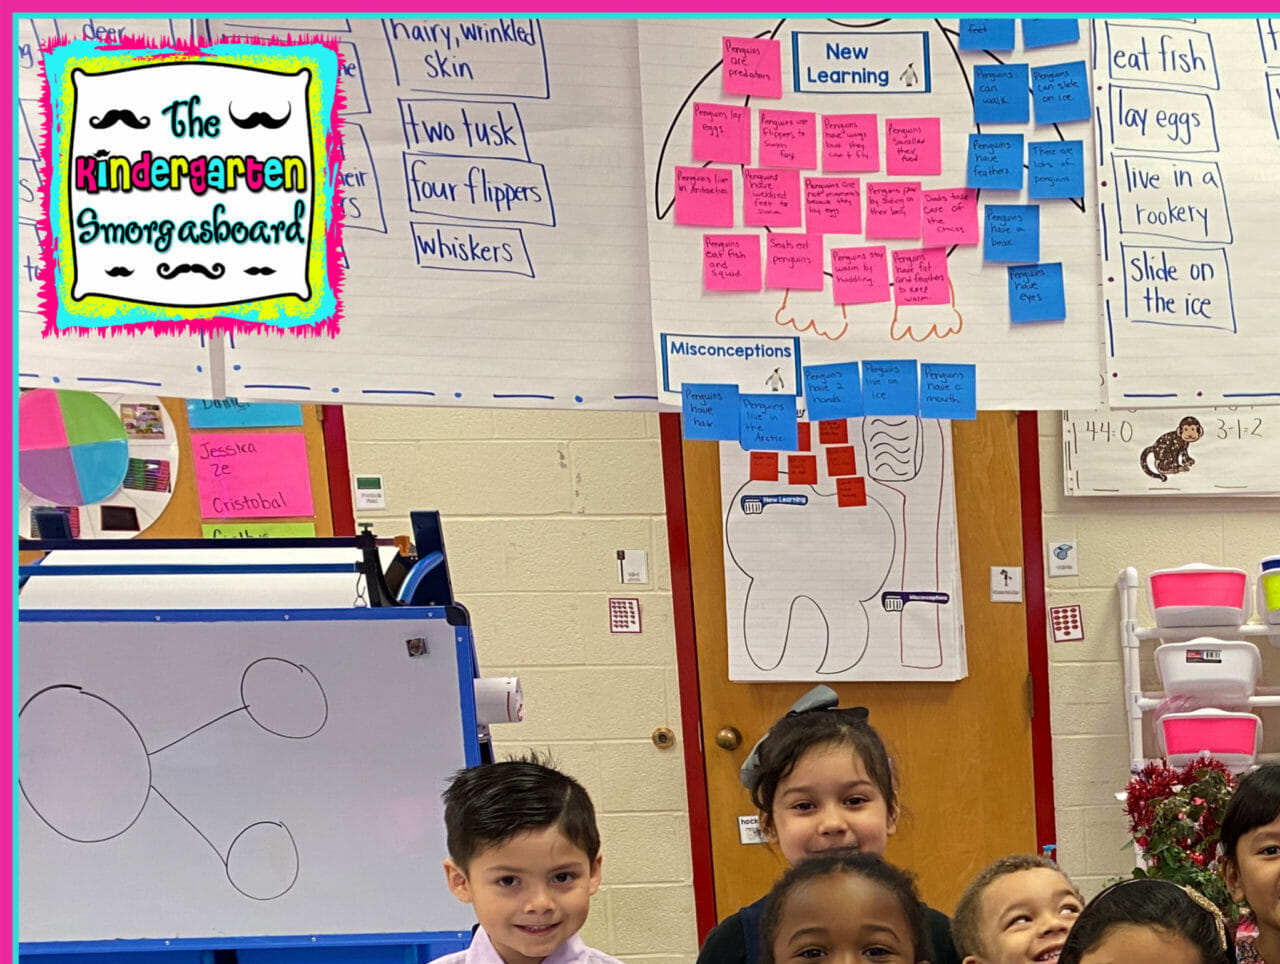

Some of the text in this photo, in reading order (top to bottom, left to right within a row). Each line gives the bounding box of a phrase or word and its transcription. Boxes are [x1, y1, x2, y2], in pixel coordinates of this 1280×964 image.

[460, 19, 536, 47] wrinkled
[826, 43, 868, 60] New
[1113, 35, 1206, 73] eat fish
[728, 68, 771, 81] predators
[807, 67, 889, 87] Learning
[979, 85, 997, 94] can
[405, 103, 517, 147] two tusk
[1119, 89, 1201, 145] lay eggs
[975, 153, 999, 163] have
[1125, 160, 1219, 192] live in a
[411, 159, 542, 212] four flippers
[1136, 198, 1209, 237] rookery
[417, 228, 513, 263] whiskers
[1190, 258, 1214, 281] on
[1015, 281, 1038, 290] have
[1019, 293, 1042, 303] eyes
[1143, 287, 1212, 319] the ice
[670, 341, 792, 360] Misconceptions
[925, 366, 964, 383] Penguins
[927, 382, 951, 390] have
[686, 388, 721, 406] Penguins
[872, 392, 886, 400] ice
[926, 394, 960, 404] mouth
[690, 404, 713, 414] have
[743, 398, 784, 414] Penguins
[694, 417, 713, 428] hair
[747, 412, 763, 421] live
[746, 423, 764, 432] the
[755, 433, 784, 442] Arctic
[200, 442, 256, 460] Jessica
[212, 491, 287, 514] Cristobal
